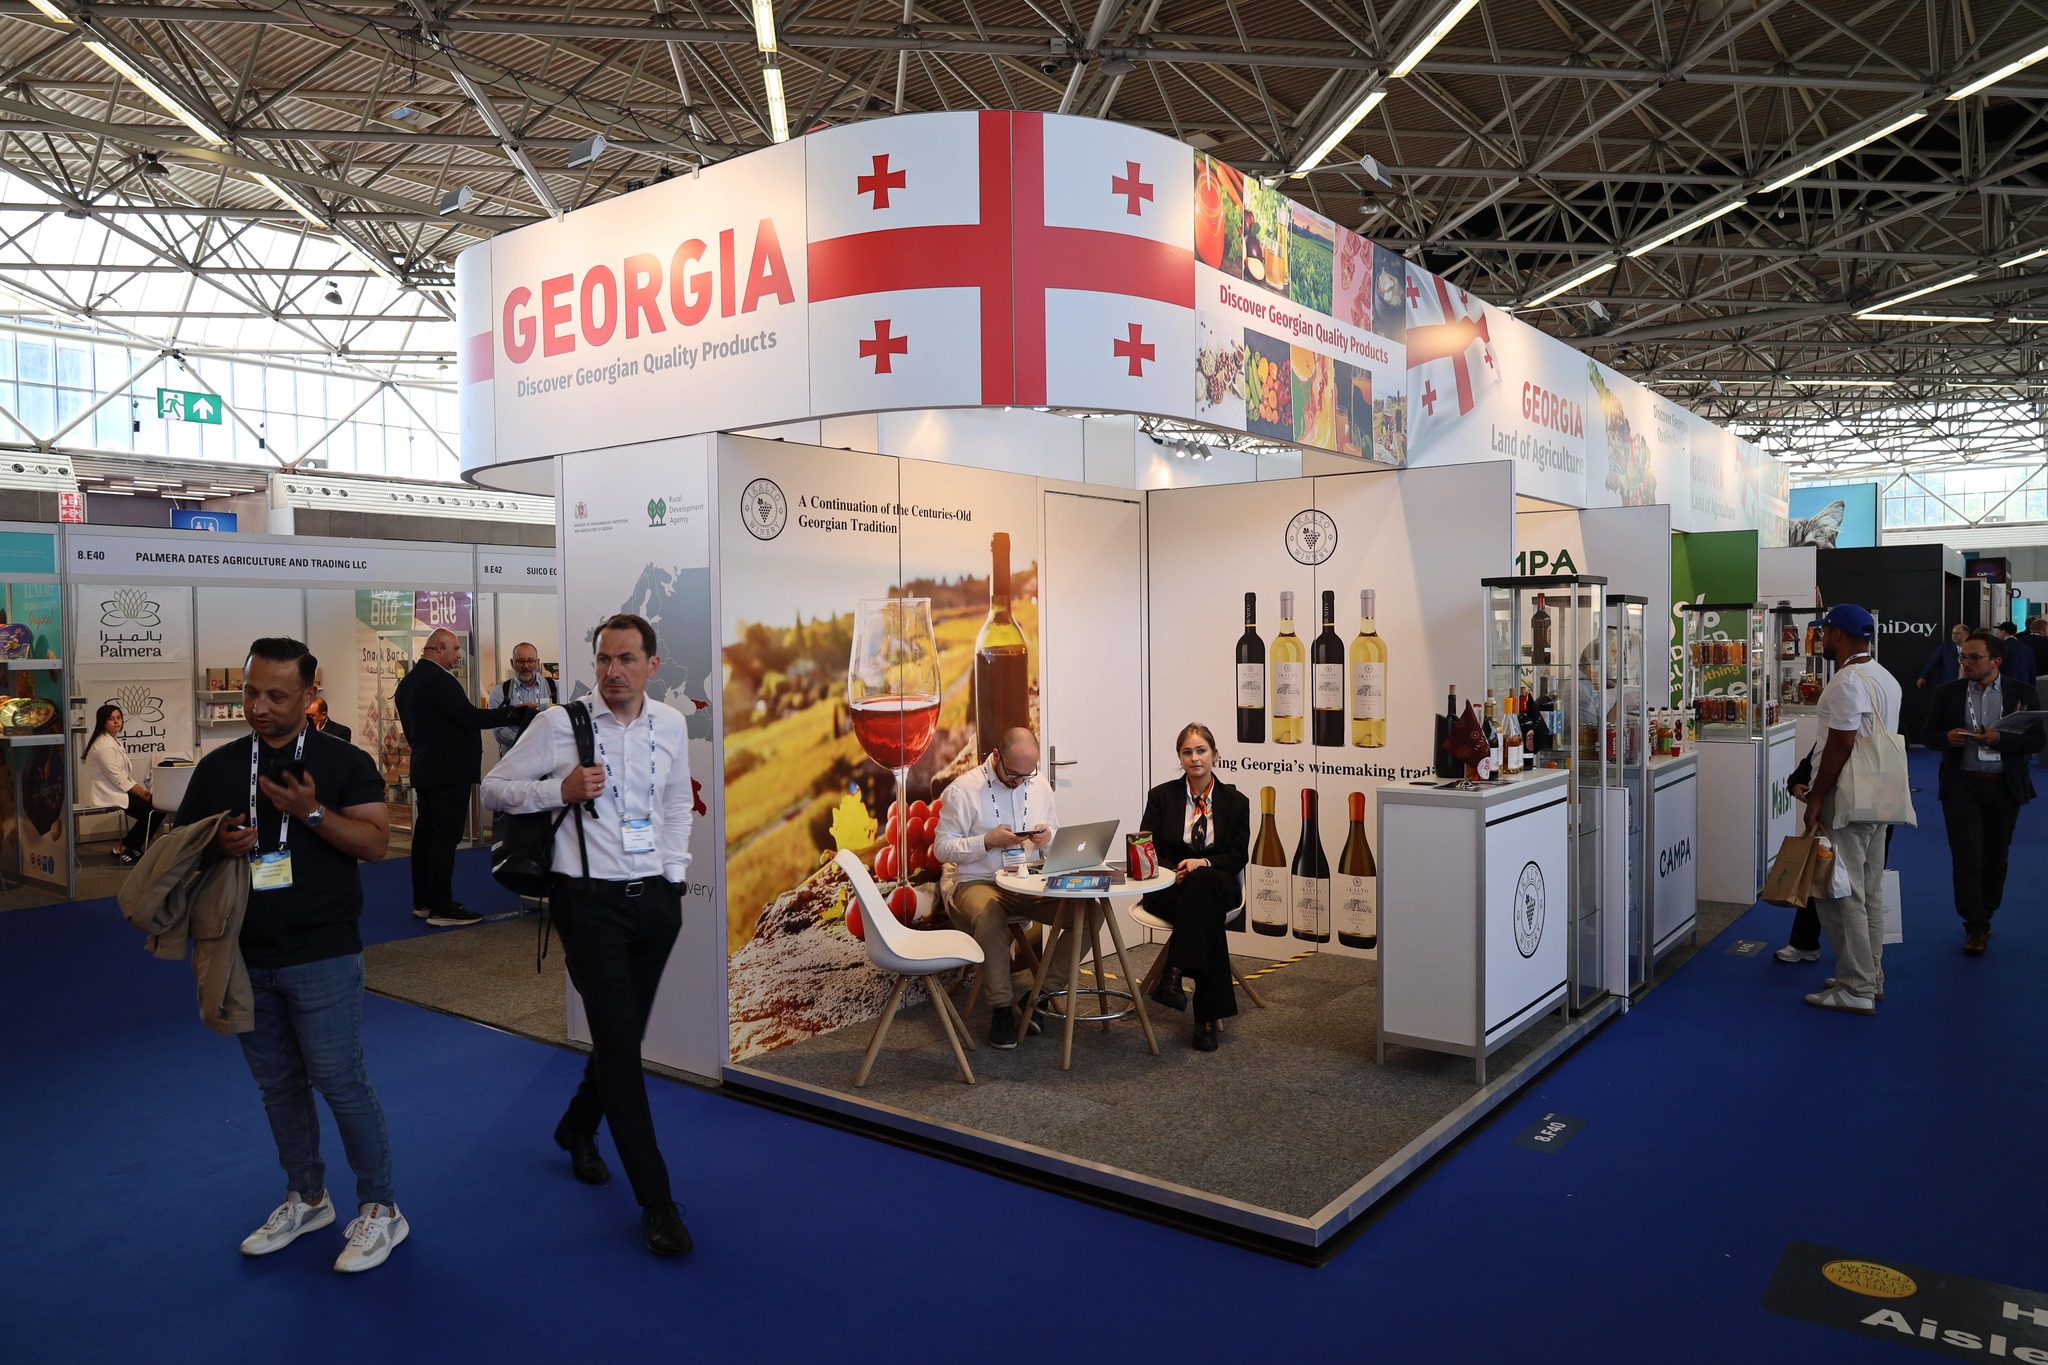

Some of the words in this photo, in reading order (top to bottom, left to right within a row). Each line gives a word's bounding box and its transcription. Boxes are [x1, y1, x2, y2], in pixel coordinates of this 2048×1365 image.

[502, 217, 796, 365] GEORGIA
[1219, 284, 1267, 320] Discover
[1268, 304, 1313, 337] Georgian
[1315, 323, 1349, 354] Quality
[1350, 336, 1389, 365] Products
[517, 372, 573, 397] Discover
[576, 356, 639, 386] Georgian
[643, 343, 699, 373] Quality
[702, 329, 778, 362] Products
[1521, 380, 1584, 440] GEORGIA
[1491, 424, 1518, 457] Land
[1519, 437, 1532, 460] of
[1532, 439, 1585, 475] Agriculture
[668, 495, 683, 503] Rural
[747, 482, 782, 502] IKALTO
[669, 504, 704, 514] Development
[798, 494, 807, 508] A
[811, 495, 878, 514] Continuation
[881, 503, 891, 515] of
[893, 503, 909, 516] the
[911, 505, 972, 522] Centuries-Old
[669, 516, 689, 526] Agency
[748, 521, 781, 536] WINERY
[798, 514, 848, 532] Georgian
[850, 518, 898, 534] Tradition
[1292, 513, 1331, 529] IKALTO
[77, 550, 105, 560] 8.E40
[135, 552, 186, 563] PALMERA
[188, 554, 220, 564] DATES
[222, 556, 287, 567] AGRICULTURE
[289, 558, 309, 567] AND
[311, 559, 351, 569] TRADING
[352, 560, 367, 569] LLC
[1293, 547, 1330, 561] WINERY
[484, 565, 503, 574] 8.E42
[526, 566, 548, 576] SUICO
[371, 599, 398, 626] Bite
[430, 596, 457, 625] Bite
[100, 630, 162, 644] بالميرا
[100, 645, 162, 658] Palmera
[387, 648, 405, 662] Bars
[123, 741, 166, 754] lmera
[1241, 757, 1305, 775] Georgia’s
[1309, 760, 1396, 781] winemaking
[1659, 836, 1692, 879] CAMPA
[1519, 868, 1542, 896] IKALTO
[1519, 926, 1541, 951] WINERY
[1533, 1122, 1567, 1142] 8.F40
[1829, 1266, 1912, 1291] PRIVATE
[1839, 1262, 1910, 1283] WORLD
[1837, 1275, 1905, 1296] LABEL
[1859, 1308, 2048, 1365] Aisle
